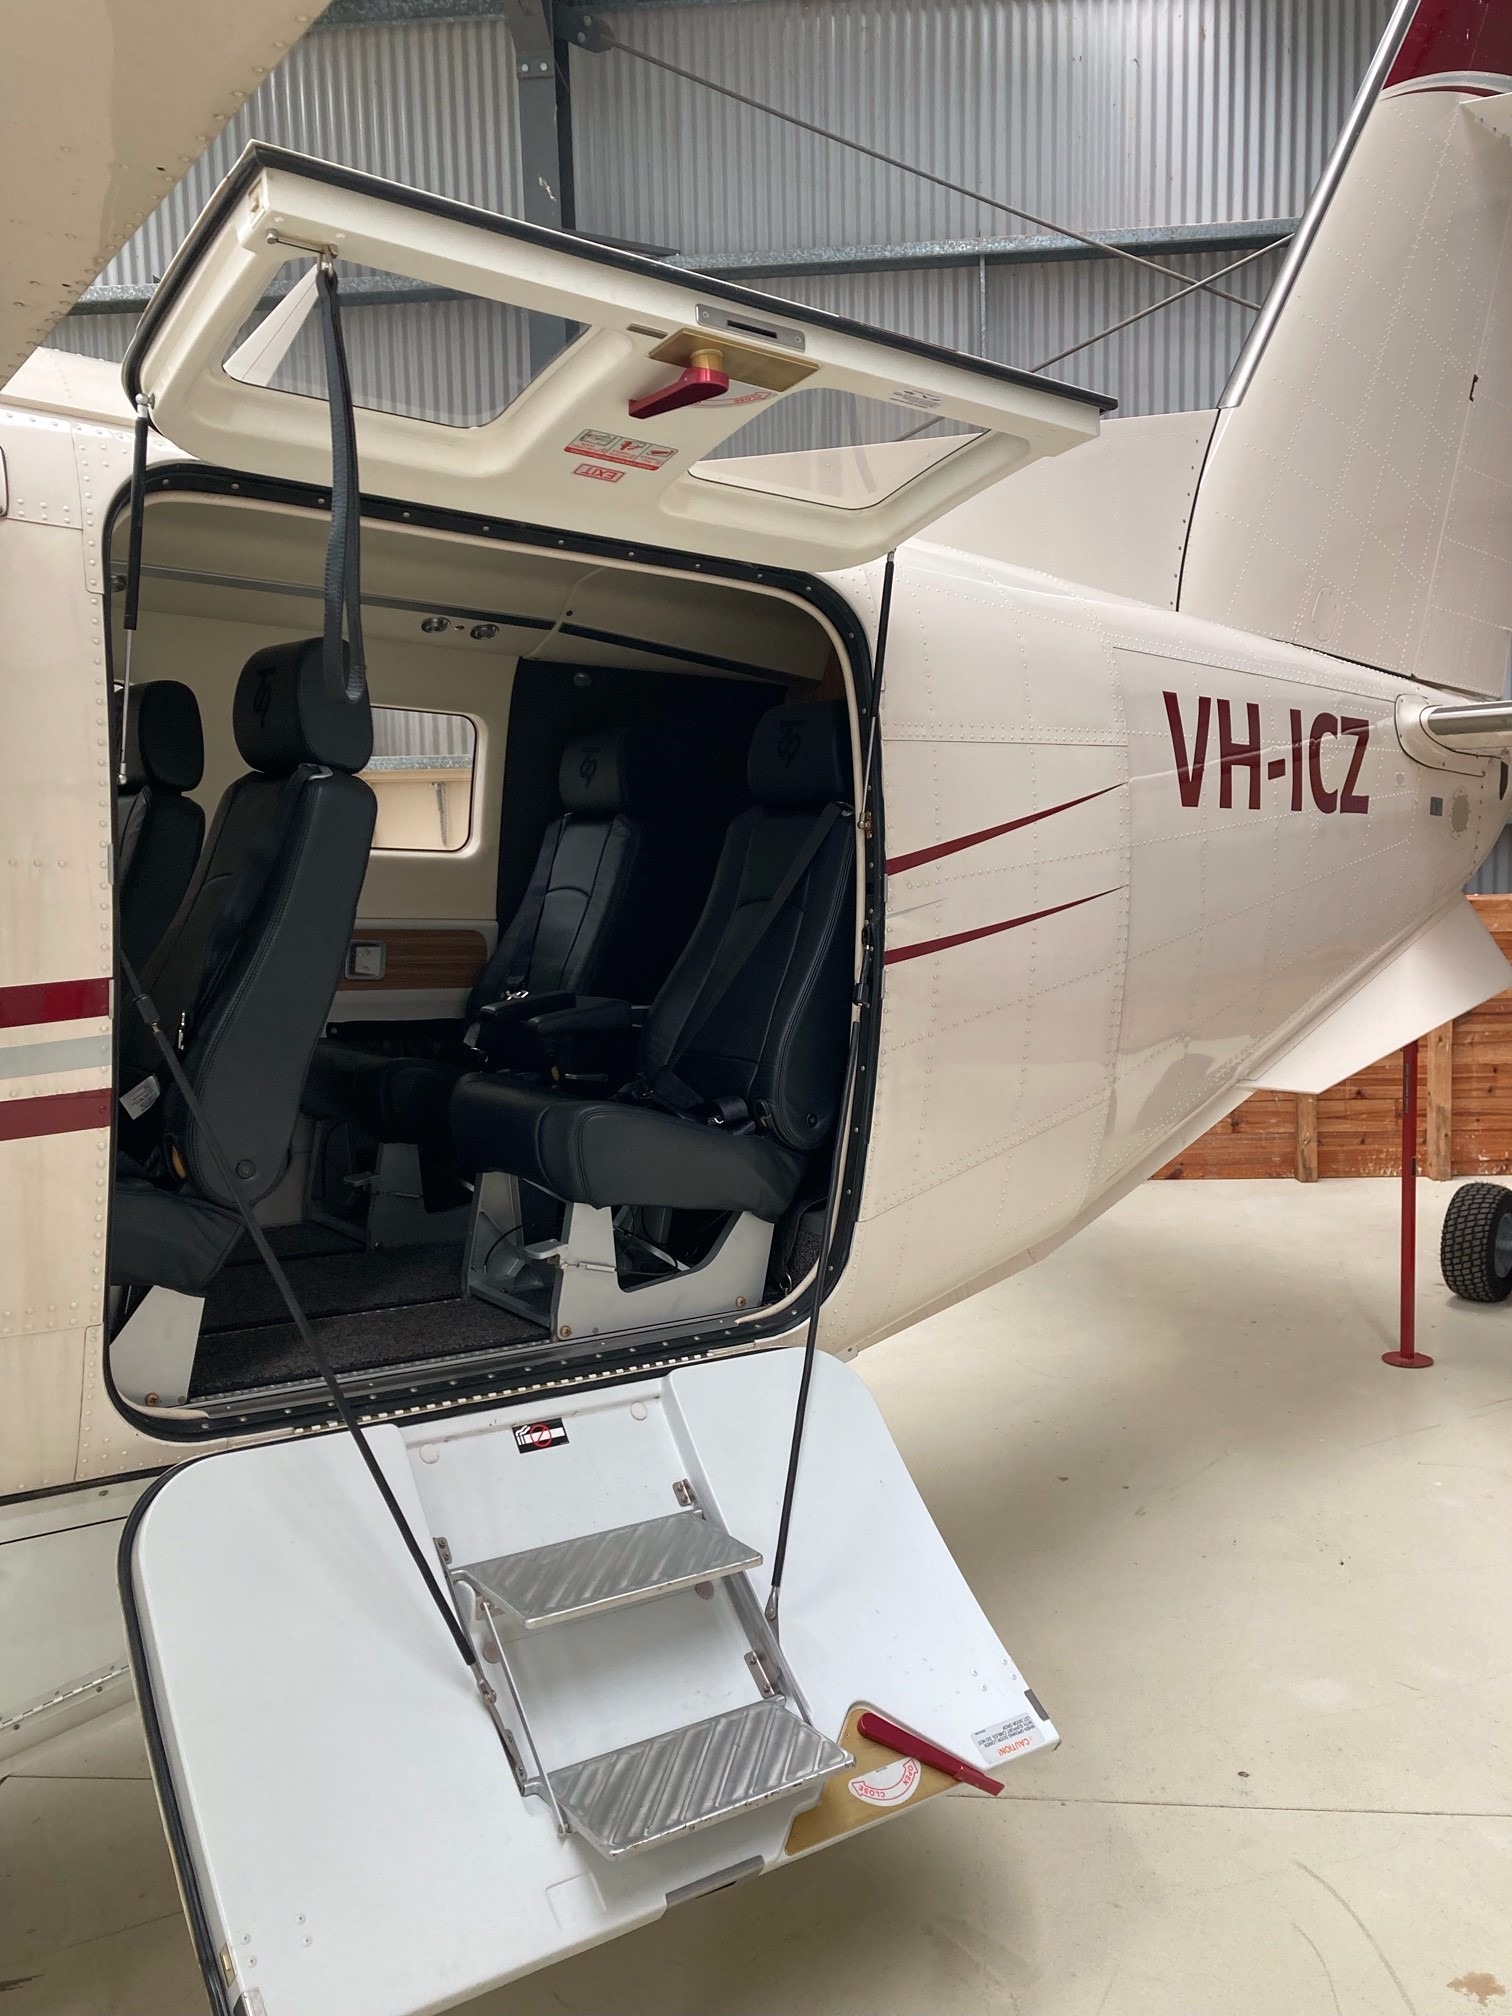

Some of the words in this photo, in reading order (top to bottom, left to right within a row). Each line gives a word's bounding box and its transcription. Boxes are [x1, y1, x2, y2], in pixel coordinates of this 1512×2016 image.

[581, 466, 618, 480] EXIT
[1162, 690, 1370, 815] VH-ICZ
[998, 1737, 1031, 1757] CAUTION!
[902, 1765, 914, 1787] OPEN
[858, 1784, 886, 1798] CLOSE
